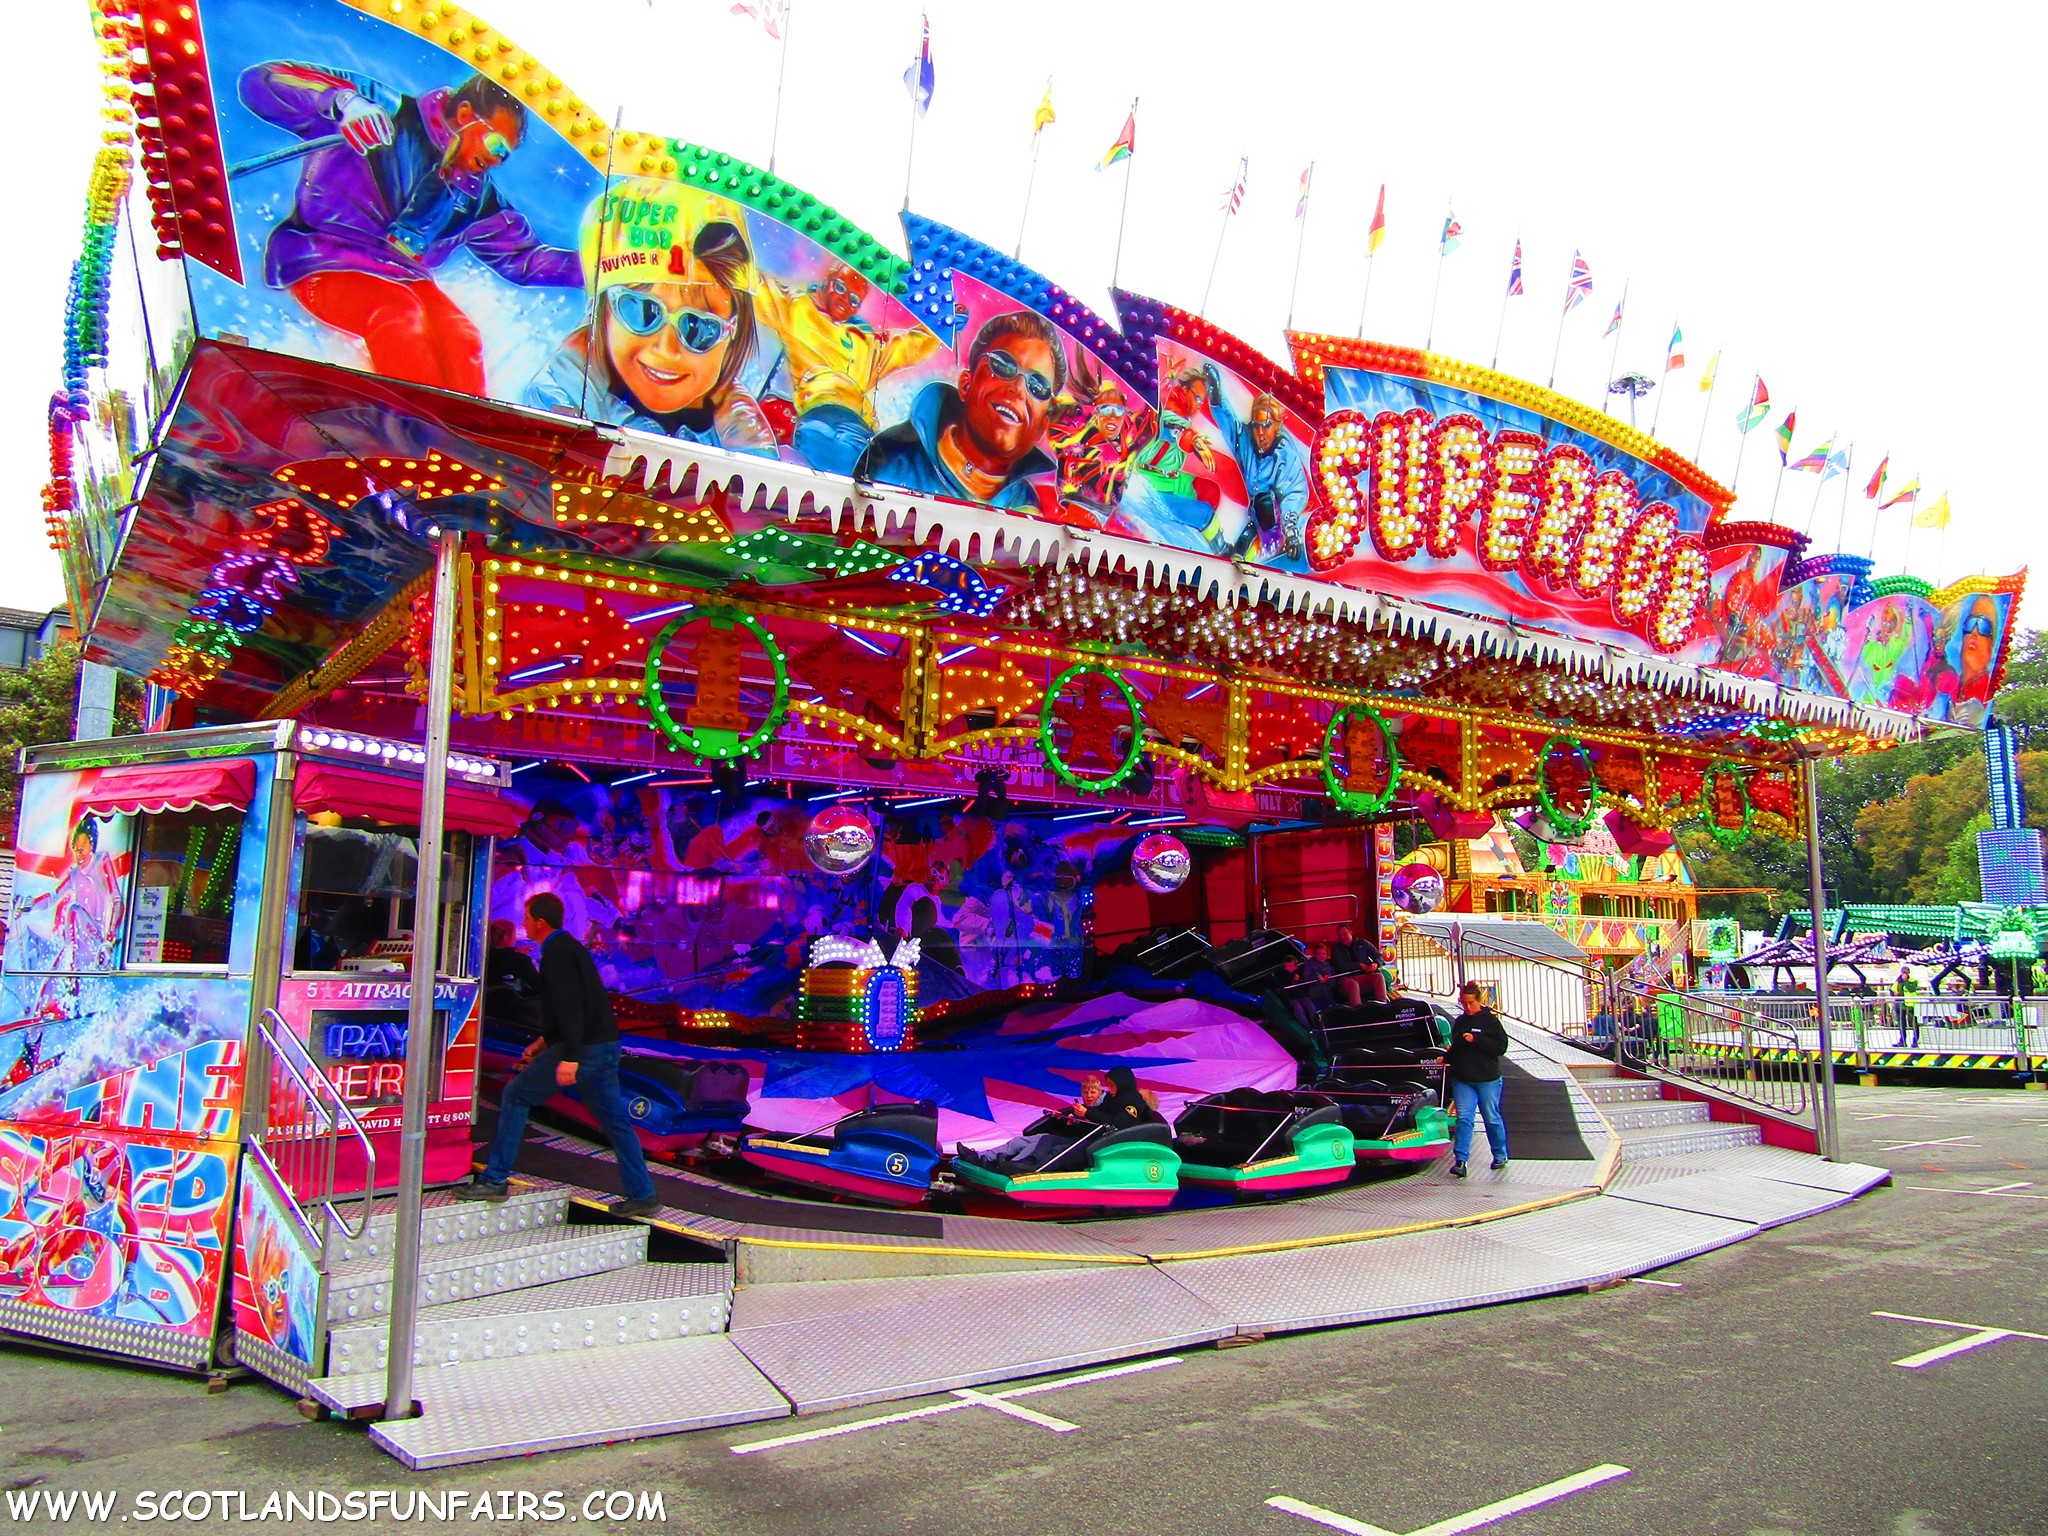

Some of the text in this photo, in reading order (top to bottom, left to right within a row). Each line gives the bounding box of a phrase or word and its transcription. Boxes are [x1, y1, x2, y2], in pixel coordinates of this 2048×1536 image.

[599, 195, 678, 226] SUPER
[629, 226, 673, 250] BOB
[667, 244, 685, 275] 1
[1304, 406, 1713, 655] SUPERBOB
[306, 982, 458, 999] 5 ATTRACON
[64, 1039, 241, 1134] THE
[310, 1063, 405, 1100] HER
[443, 1113, 451, 1122] &
[633, 1101, 646, 1115] 4
[891, 1158, 904, 1172] 5
